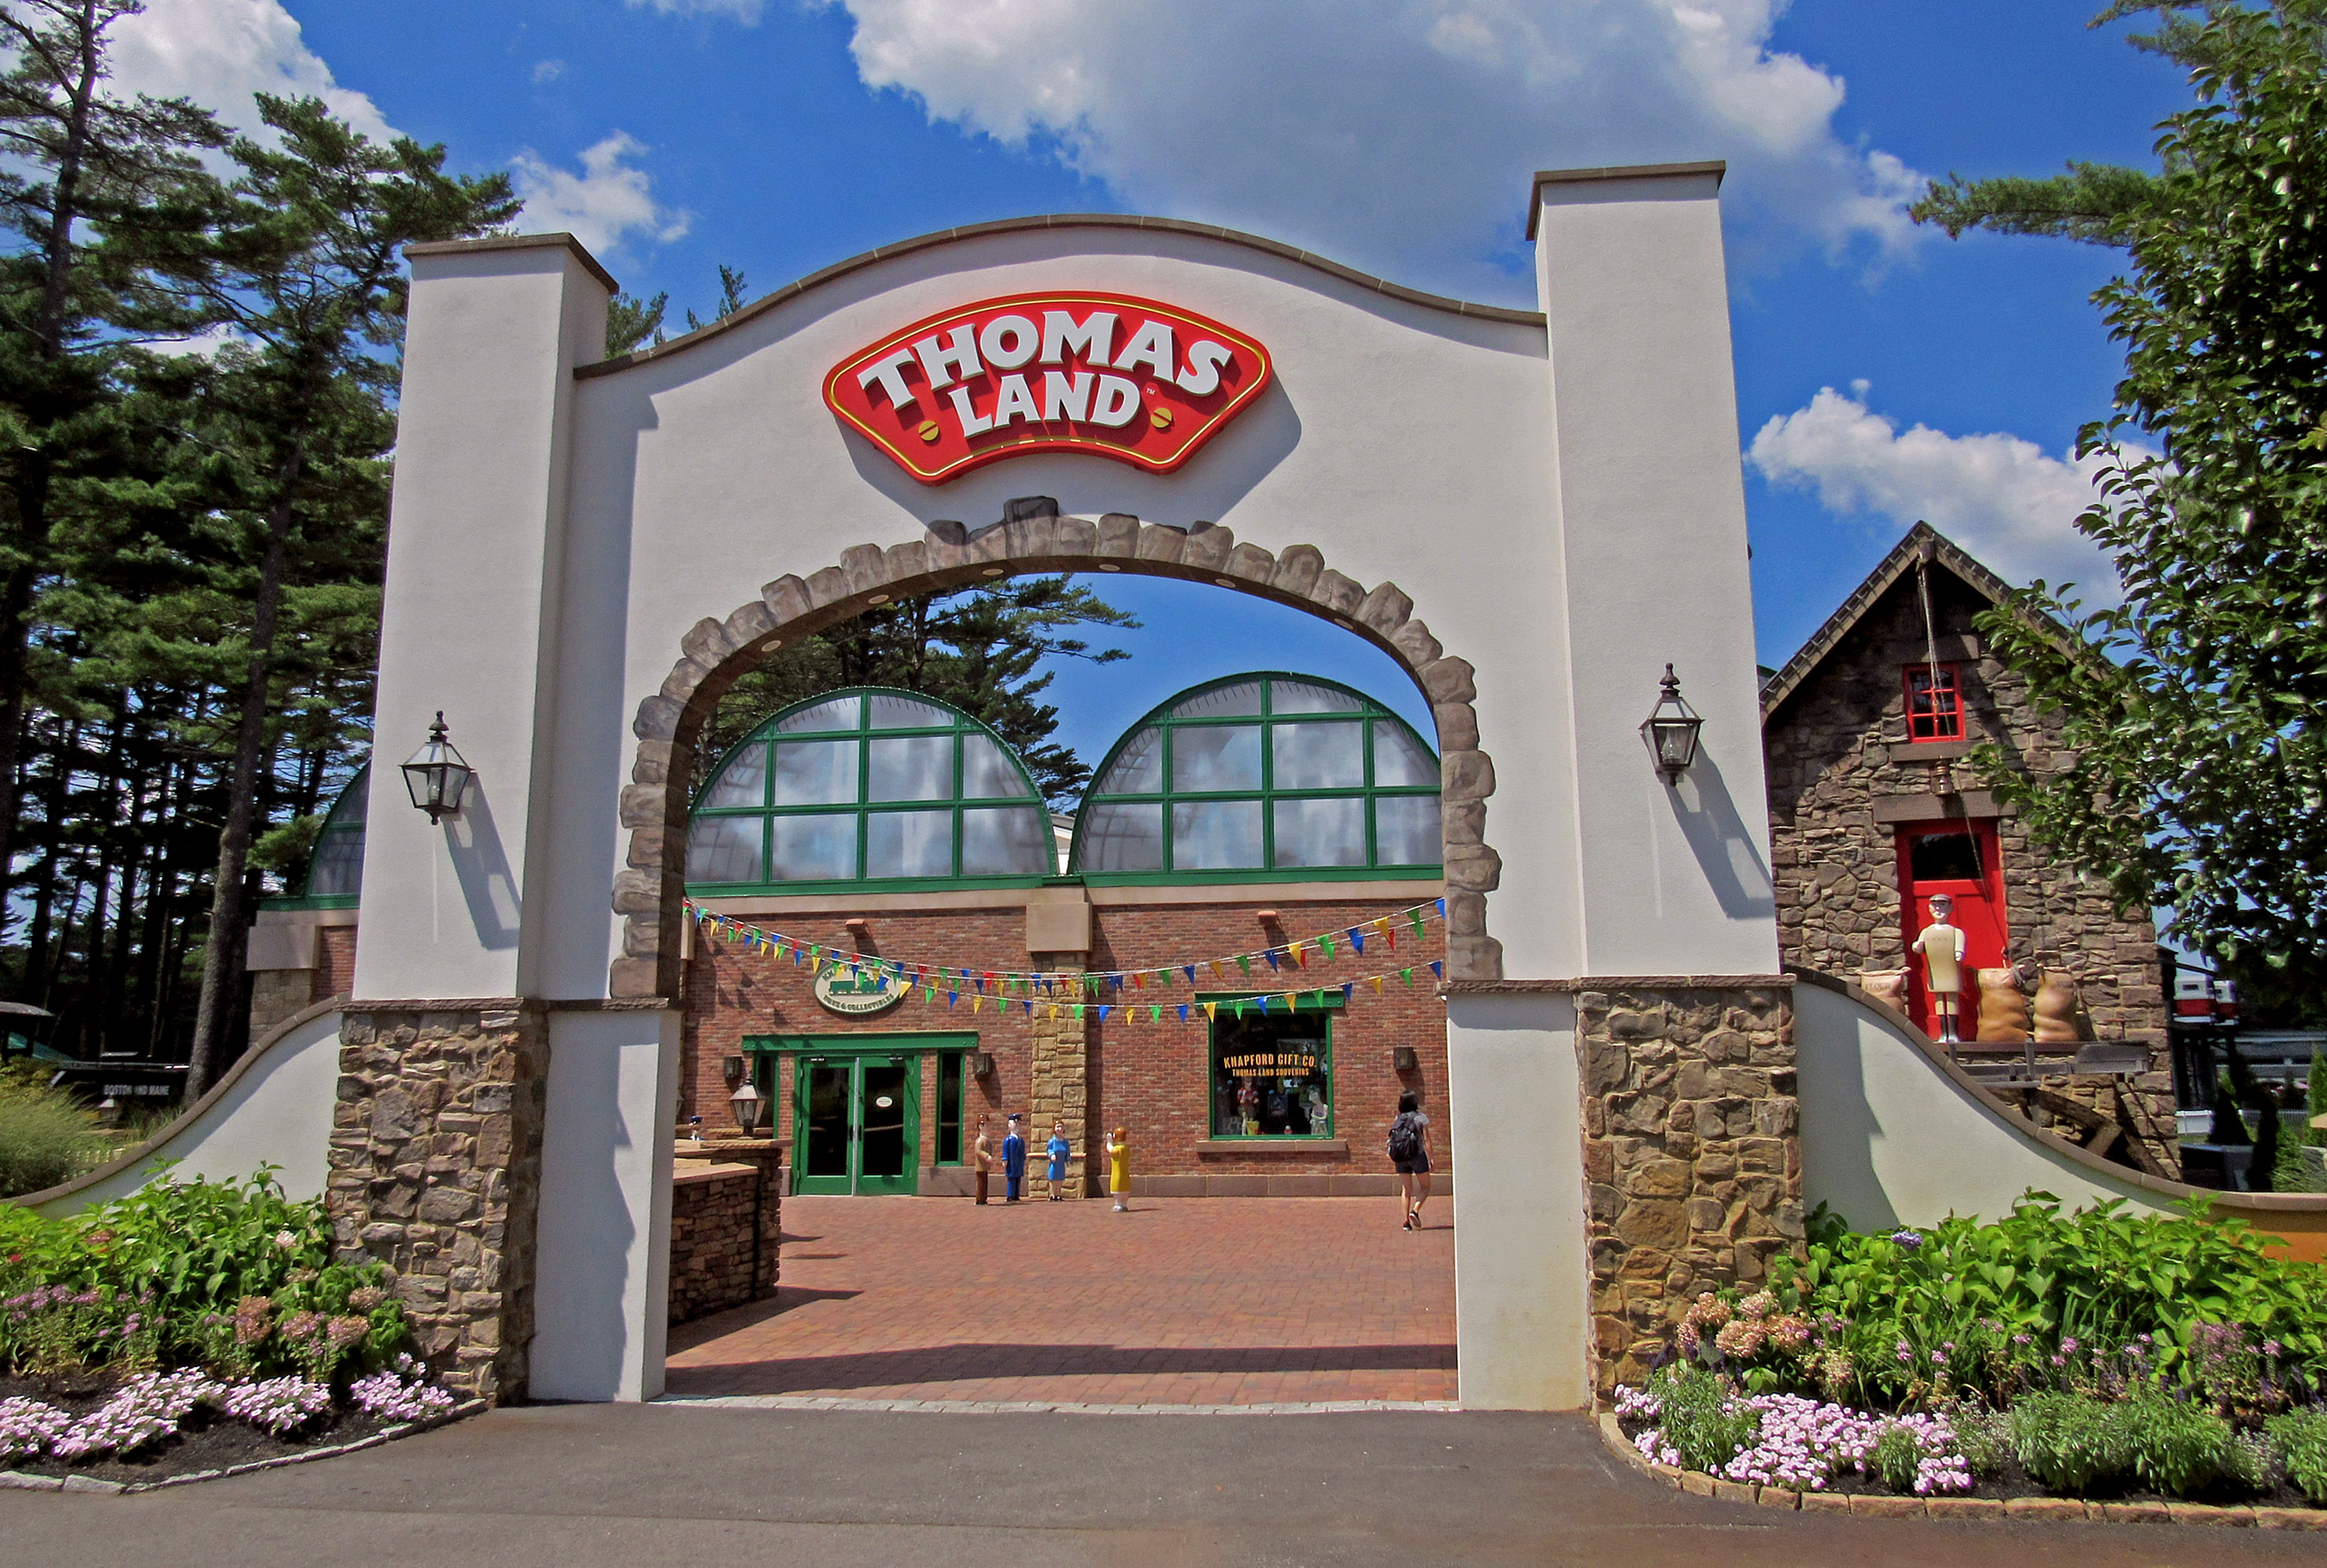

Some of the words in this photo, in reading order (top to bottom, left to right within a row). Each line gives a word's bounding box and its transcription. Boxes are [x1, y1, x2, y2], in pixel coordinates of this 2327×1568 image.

[857, 310, 1234, 411] THOMAS
[947, 371, 1141, 437] LAND
[823, 994, 840, 1008] TOYS
[847, 993, 894, 1011] COLLECTIBLES
[1223, 1054, 1274, 1069] KNAPFORD
[1278, 1054, 1299, 1066] GIFT
[1303, 1055, 1316, 1068] CO.
[1232, 1068, 1257, 1077] THOMAS
[1258, 1068, 1274, 1077] LAND
[1276, 1068, 1310, 1077] SOUVENIRS
